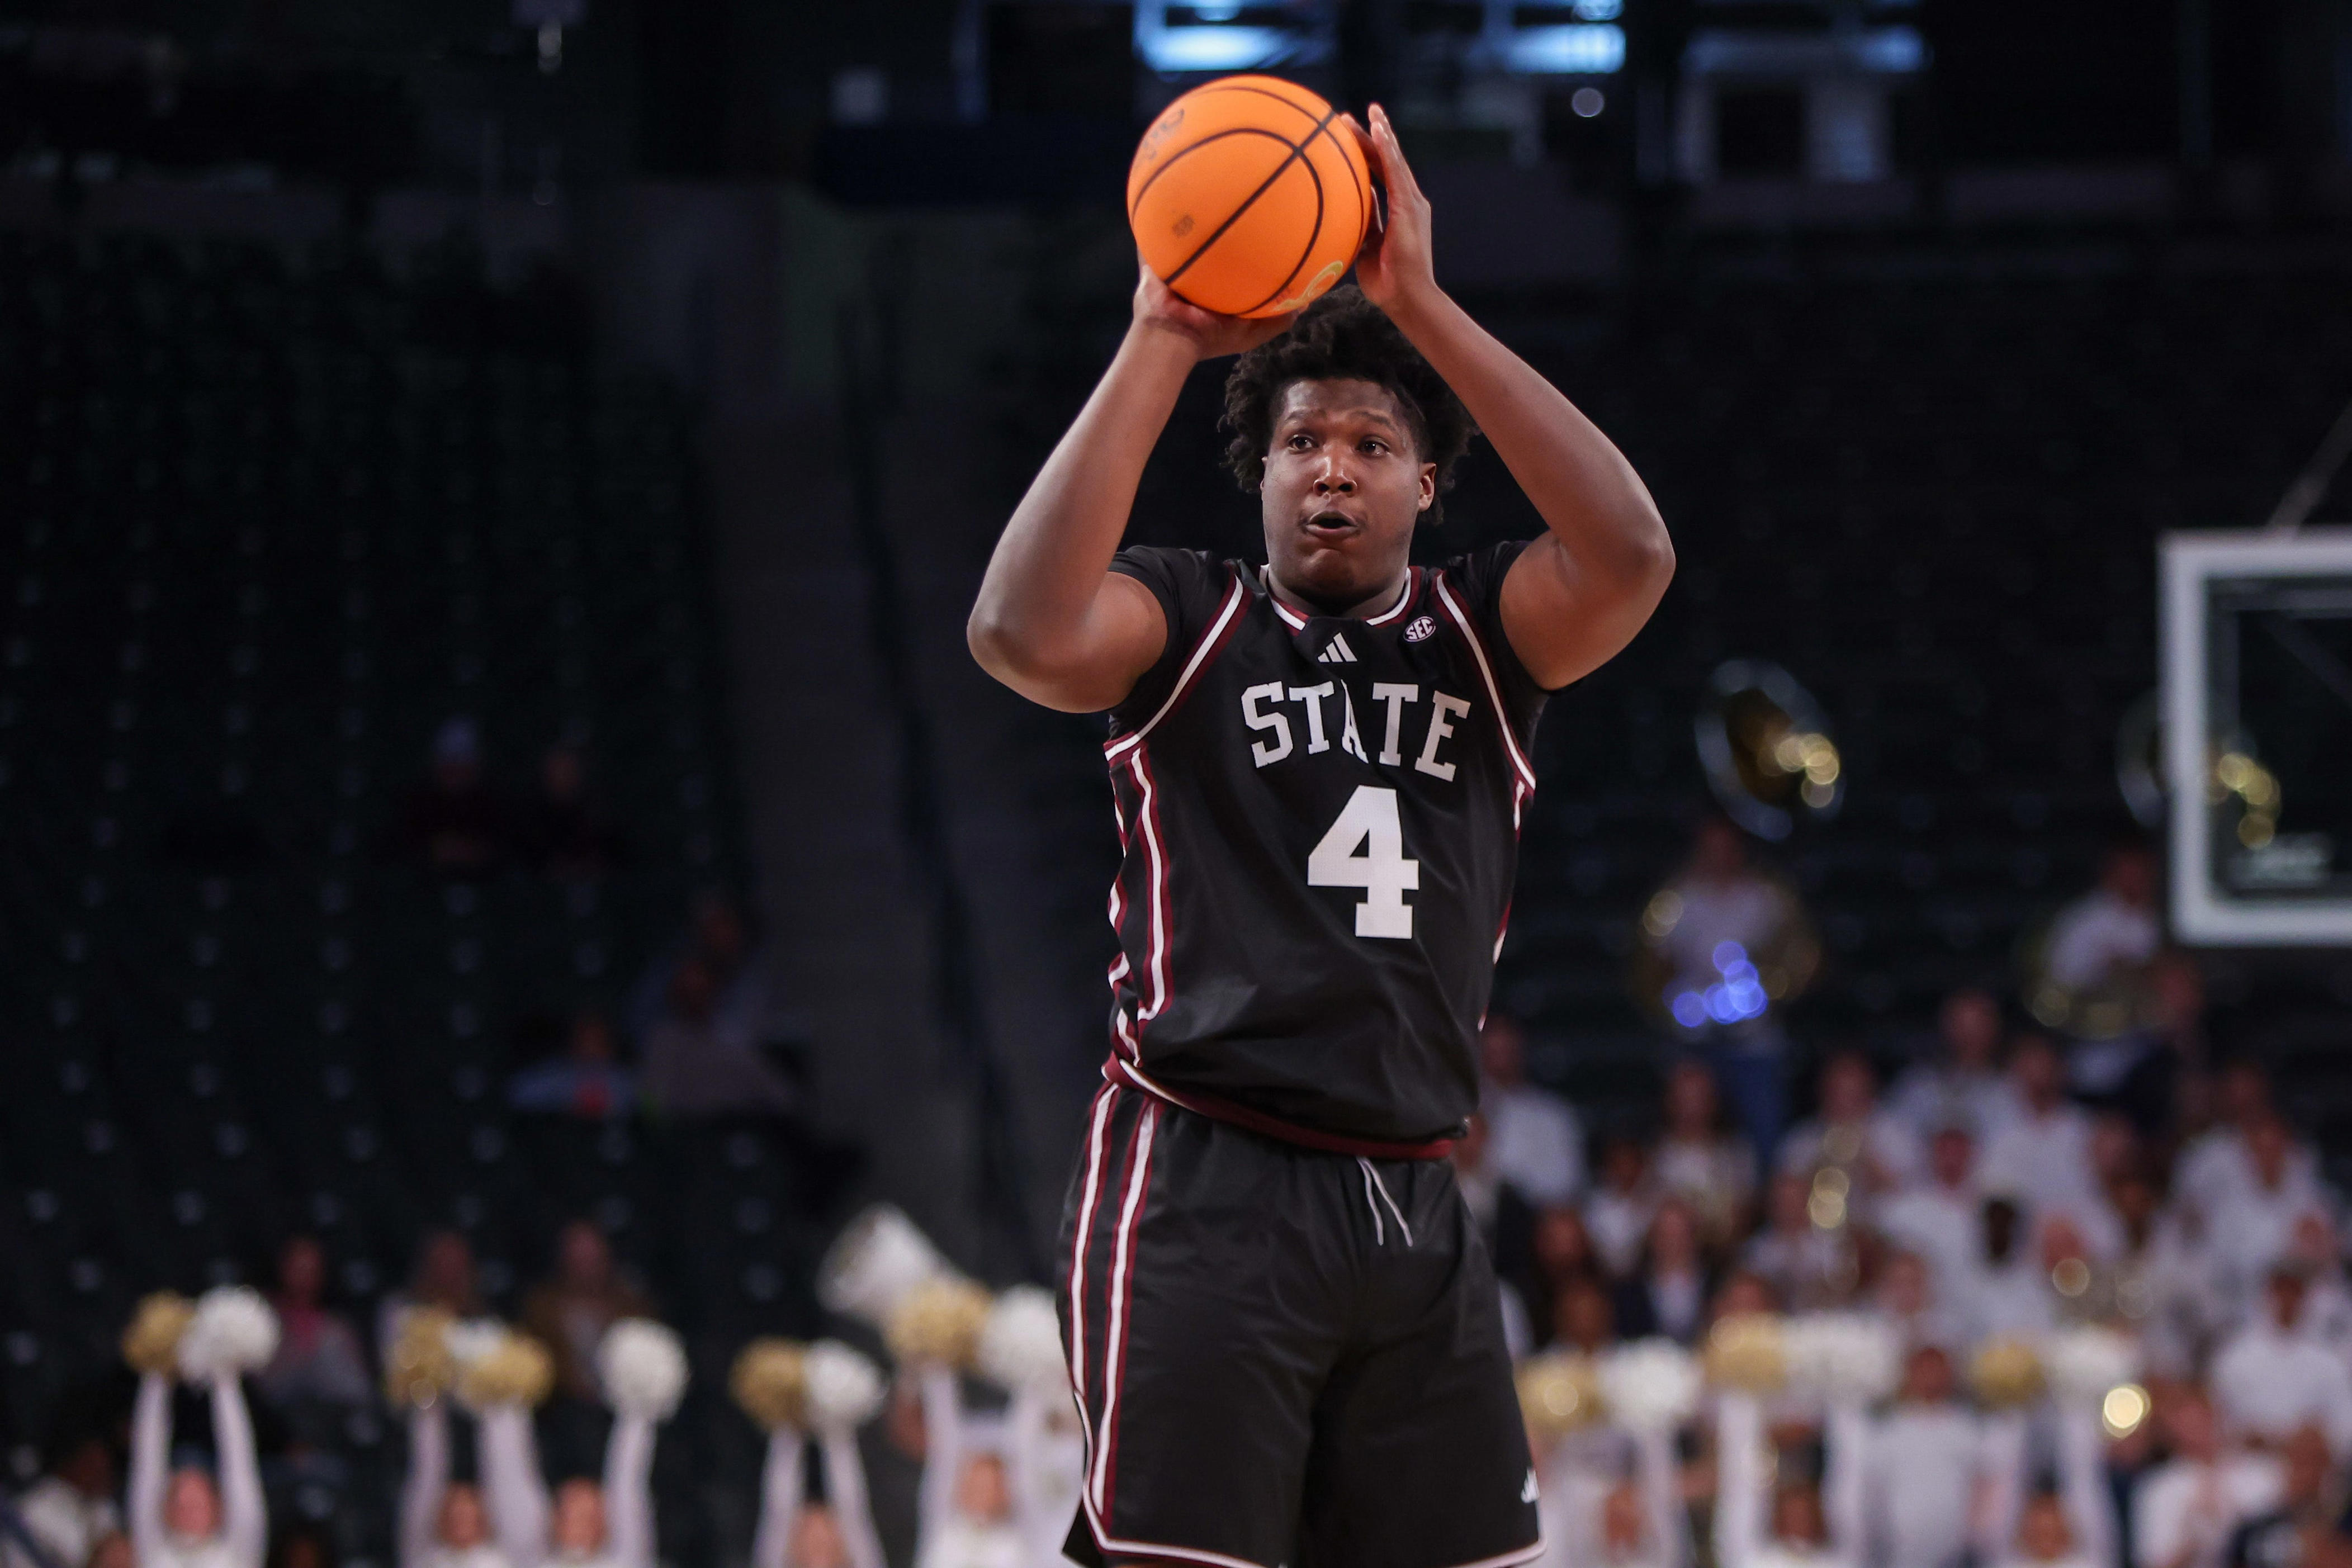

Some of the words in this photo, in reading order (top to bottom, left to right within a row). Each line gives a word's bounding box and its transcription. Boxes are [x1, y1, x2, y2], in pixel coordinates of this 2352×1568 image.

[1405, 618, 1433, 640] SEC
[1241, 679, 1471, 782] STATE
[1307, 785, 1419, 940] 4
